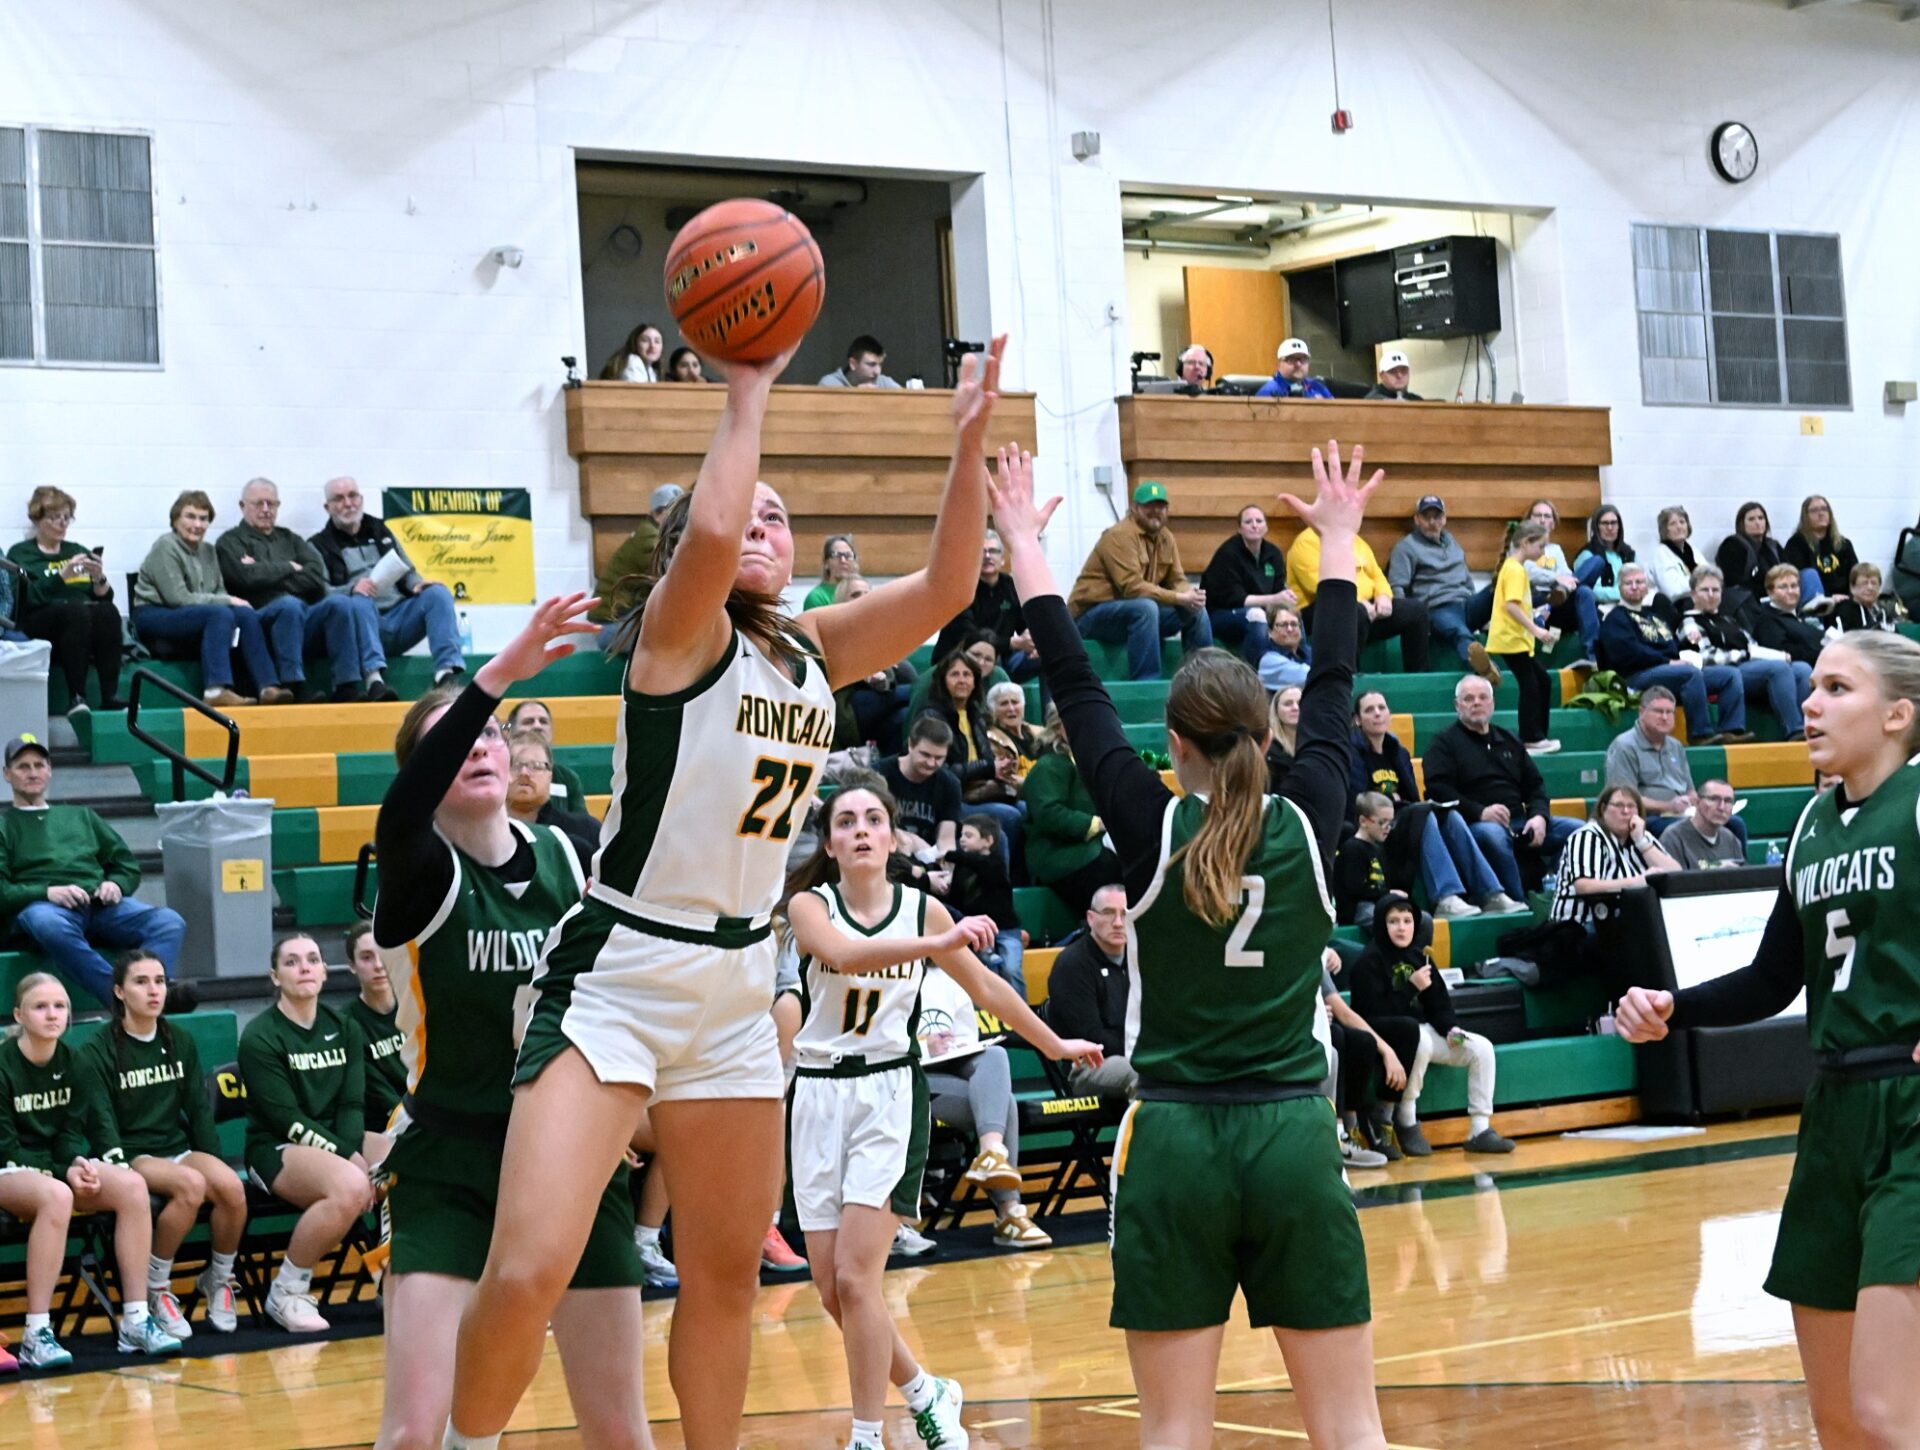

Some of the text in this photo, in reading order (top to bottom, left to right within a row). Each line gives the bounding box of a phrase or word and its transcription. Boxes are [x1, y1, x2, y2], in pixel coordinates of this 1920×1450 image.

[411, 490, 502, 512] IN MEMORY OF
[401, 520, 516, 550] Grandma Jane
[426, 543, 495, 566] Hammer
[736, 754, 816, 844] 22
[894, 799, 936, 824] NCALL
[1795, 845, 1896, 911] WILDCATS
[1224, 874, 1266, 968] 2
[1825, 907, 1857, 993] 5
[842, 986, 882, 1036] 11
[288, 1047, 347, 1071] RONCALLI
[13, 1087, 72, 1113] RONCALLI
[1041, 1095, 1101, 1115] RONCALLI
